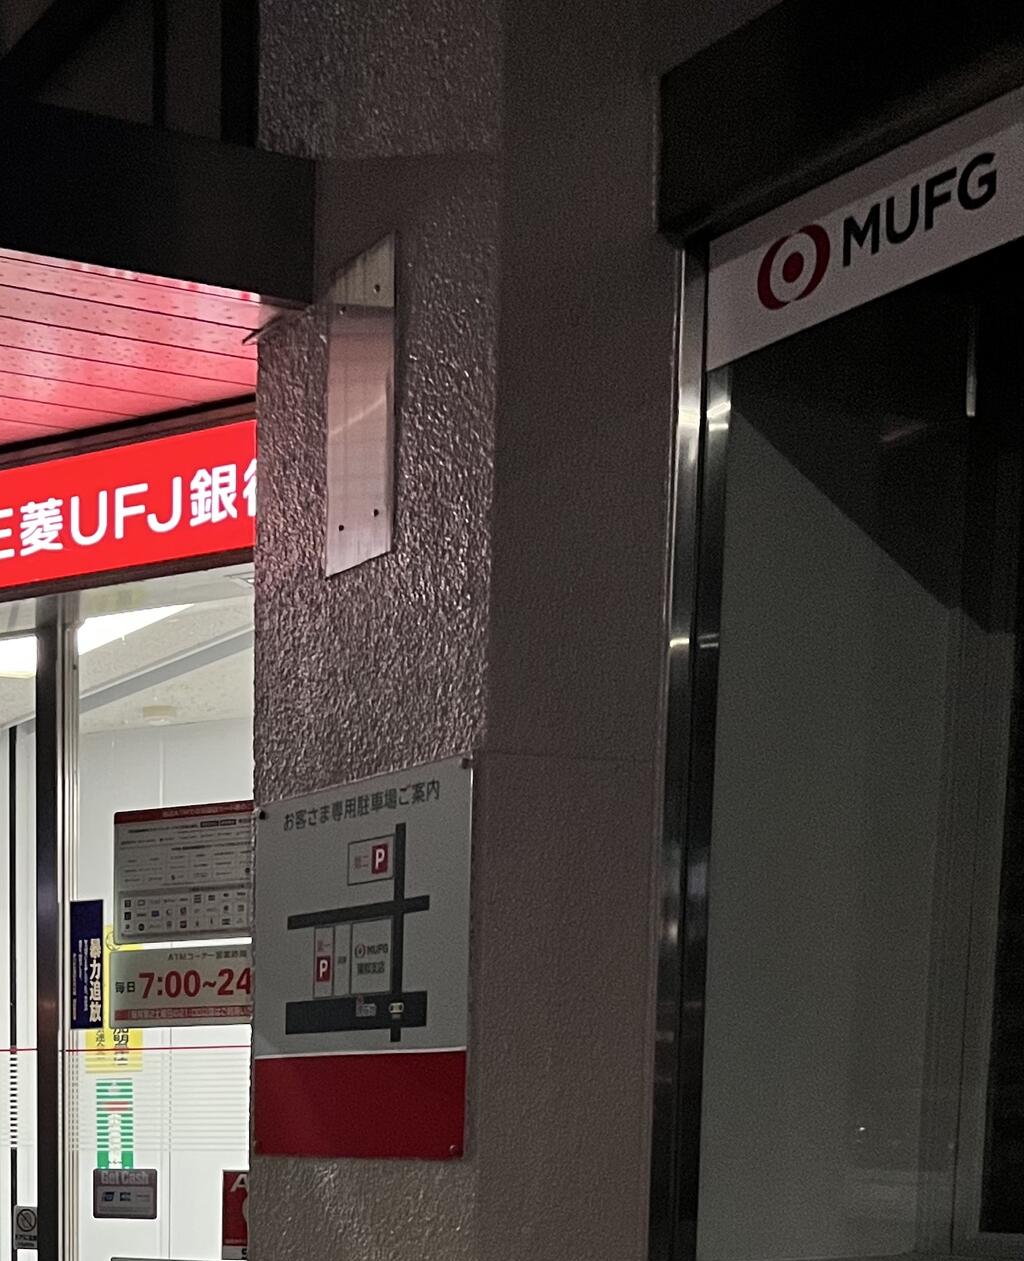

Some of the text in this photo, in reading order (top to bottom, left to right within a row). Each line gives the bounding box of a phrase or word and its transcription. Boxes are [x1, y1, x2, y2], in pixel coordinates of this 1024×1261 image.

[842, 152, 997, 267] MUFG
[283, 780, 441, 831] お客さま専用駐車場ご案内
[375, 848, 386, 870] P
[89, 938, 101, 1022] 暴力追放
[319, 959, 329, 979] P
[115, 981, 136, 995] 毎日
[121, 1170, 149, 1185] Cash
